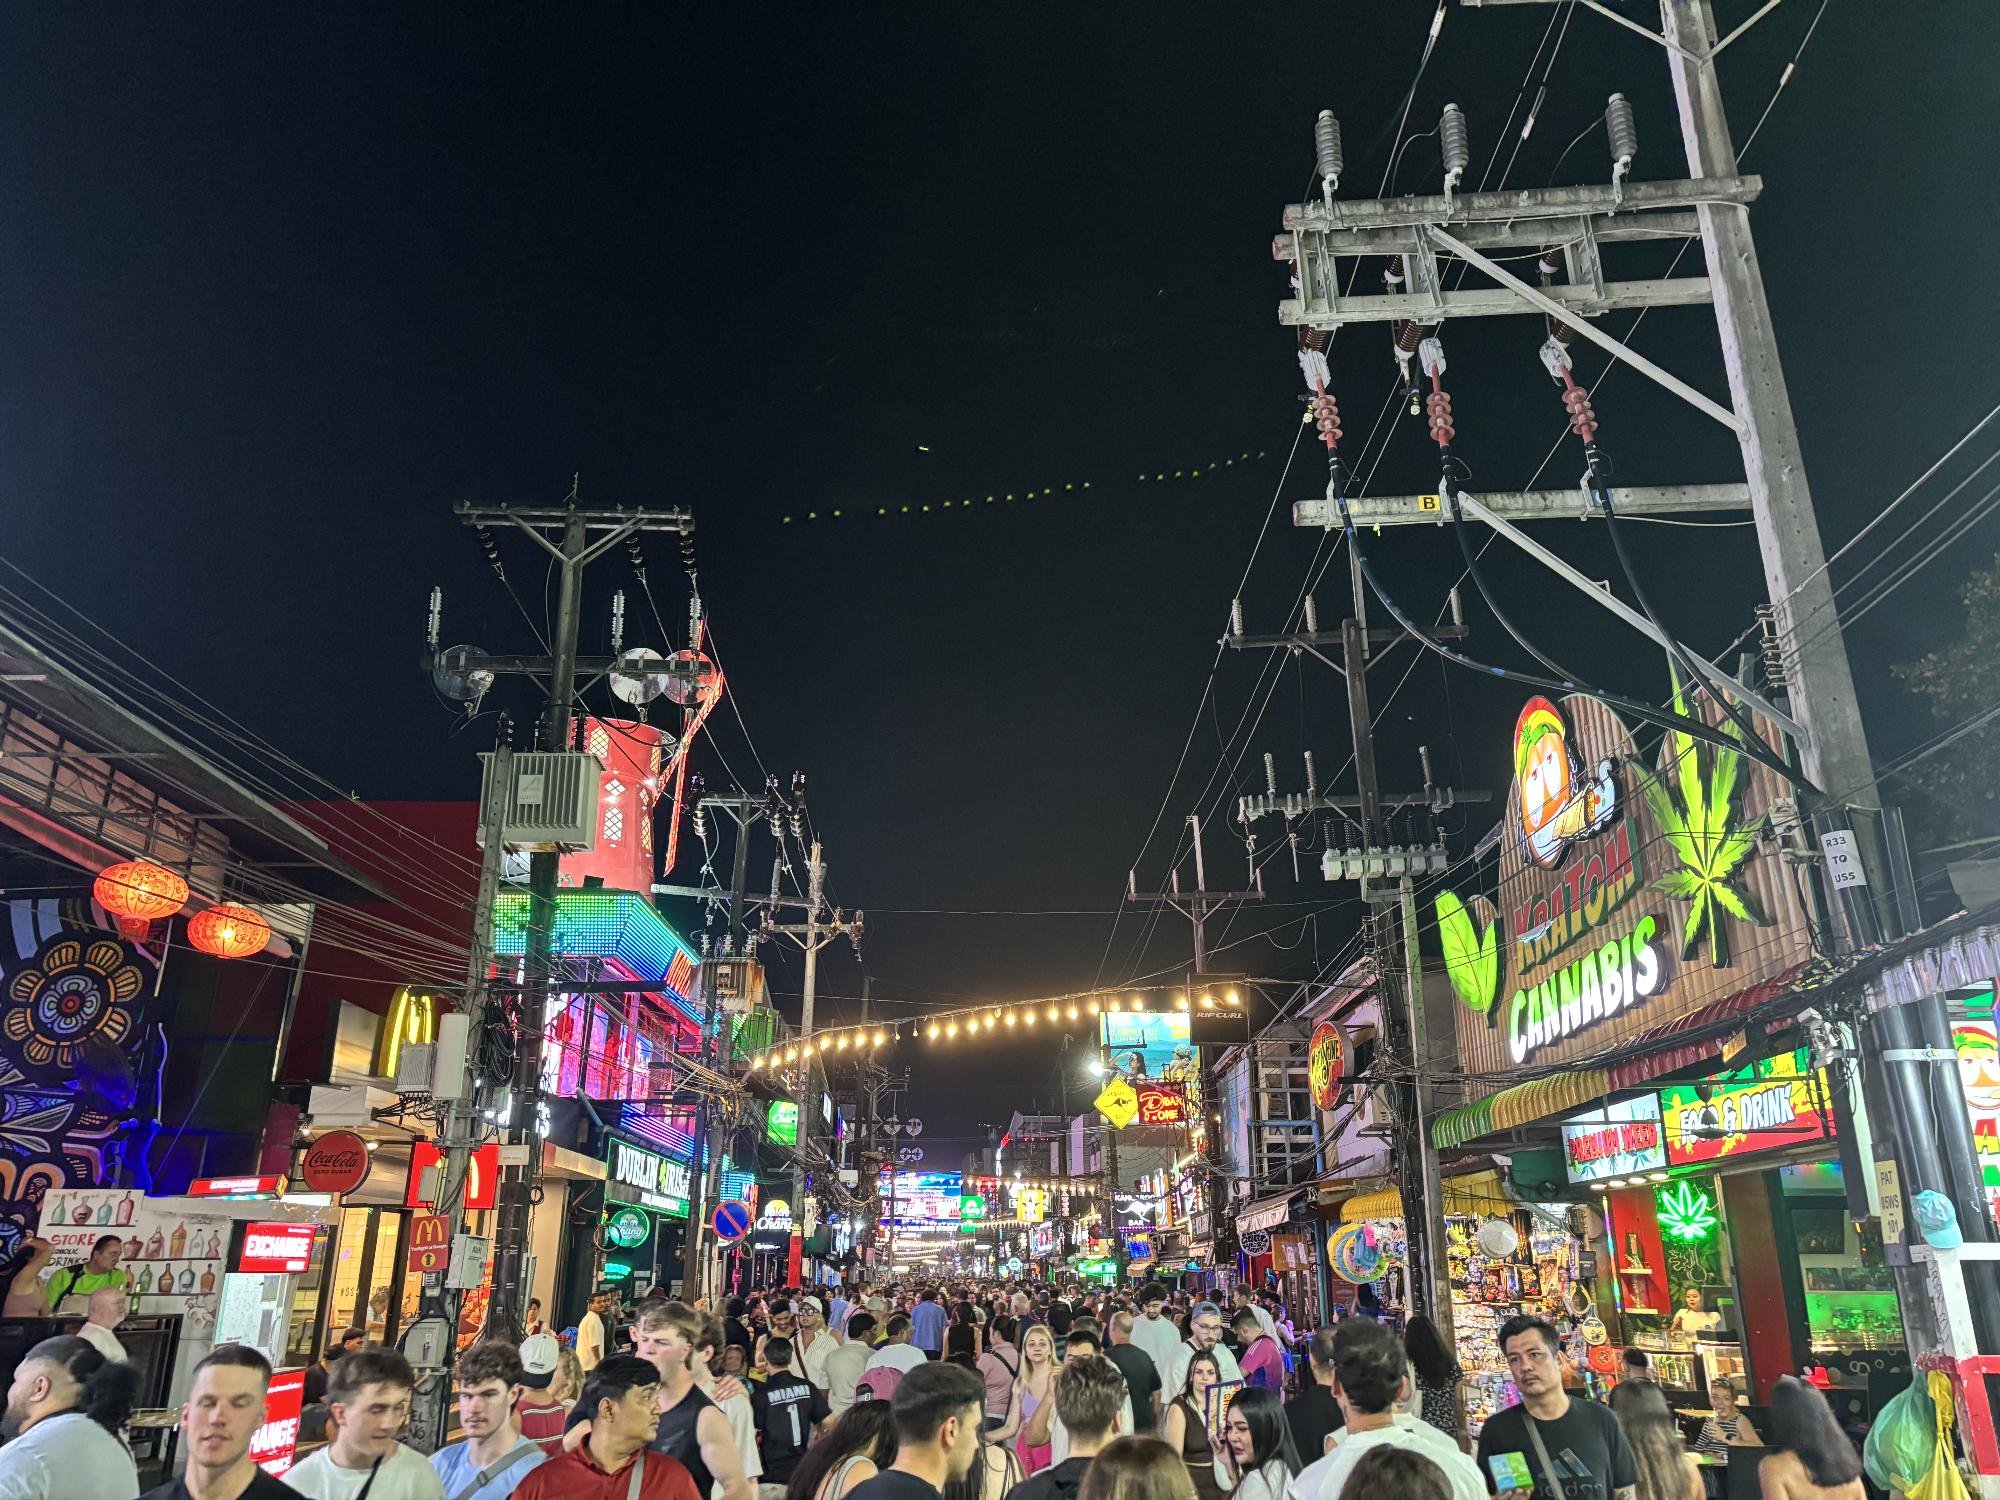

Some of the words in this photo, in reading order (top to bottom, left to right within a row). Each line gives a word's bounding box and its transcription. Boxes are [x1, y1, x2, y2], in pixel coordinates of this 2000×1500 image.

[1423, 496, 1436, 510] B
[1825, 836, 1846, 847] R33
[1832, 854, 1848, 864] TO
[1834, 871, 1856, 883] US5
[1513, 820, 1636, 976] KRATOM
[1510, 915, 1659, 1064] CANNABIS
[1740, 1082, 1795, 1130] DRINK
[1568, 1127, 1622, 1166] PREMIUM
[1620, 1122, 1658, 1153] WEED
[616, 1145, 660, 1192] DUBLIN
[1880, 1170, 1893, 1185] PAT
[51, 1232, 97, 1246] STORE
[245, 1235, 310, 1258] EXCHANGE
[768, 1385, 811, 1403] MIAMI
[788, 1403, 801, 1447] 1
